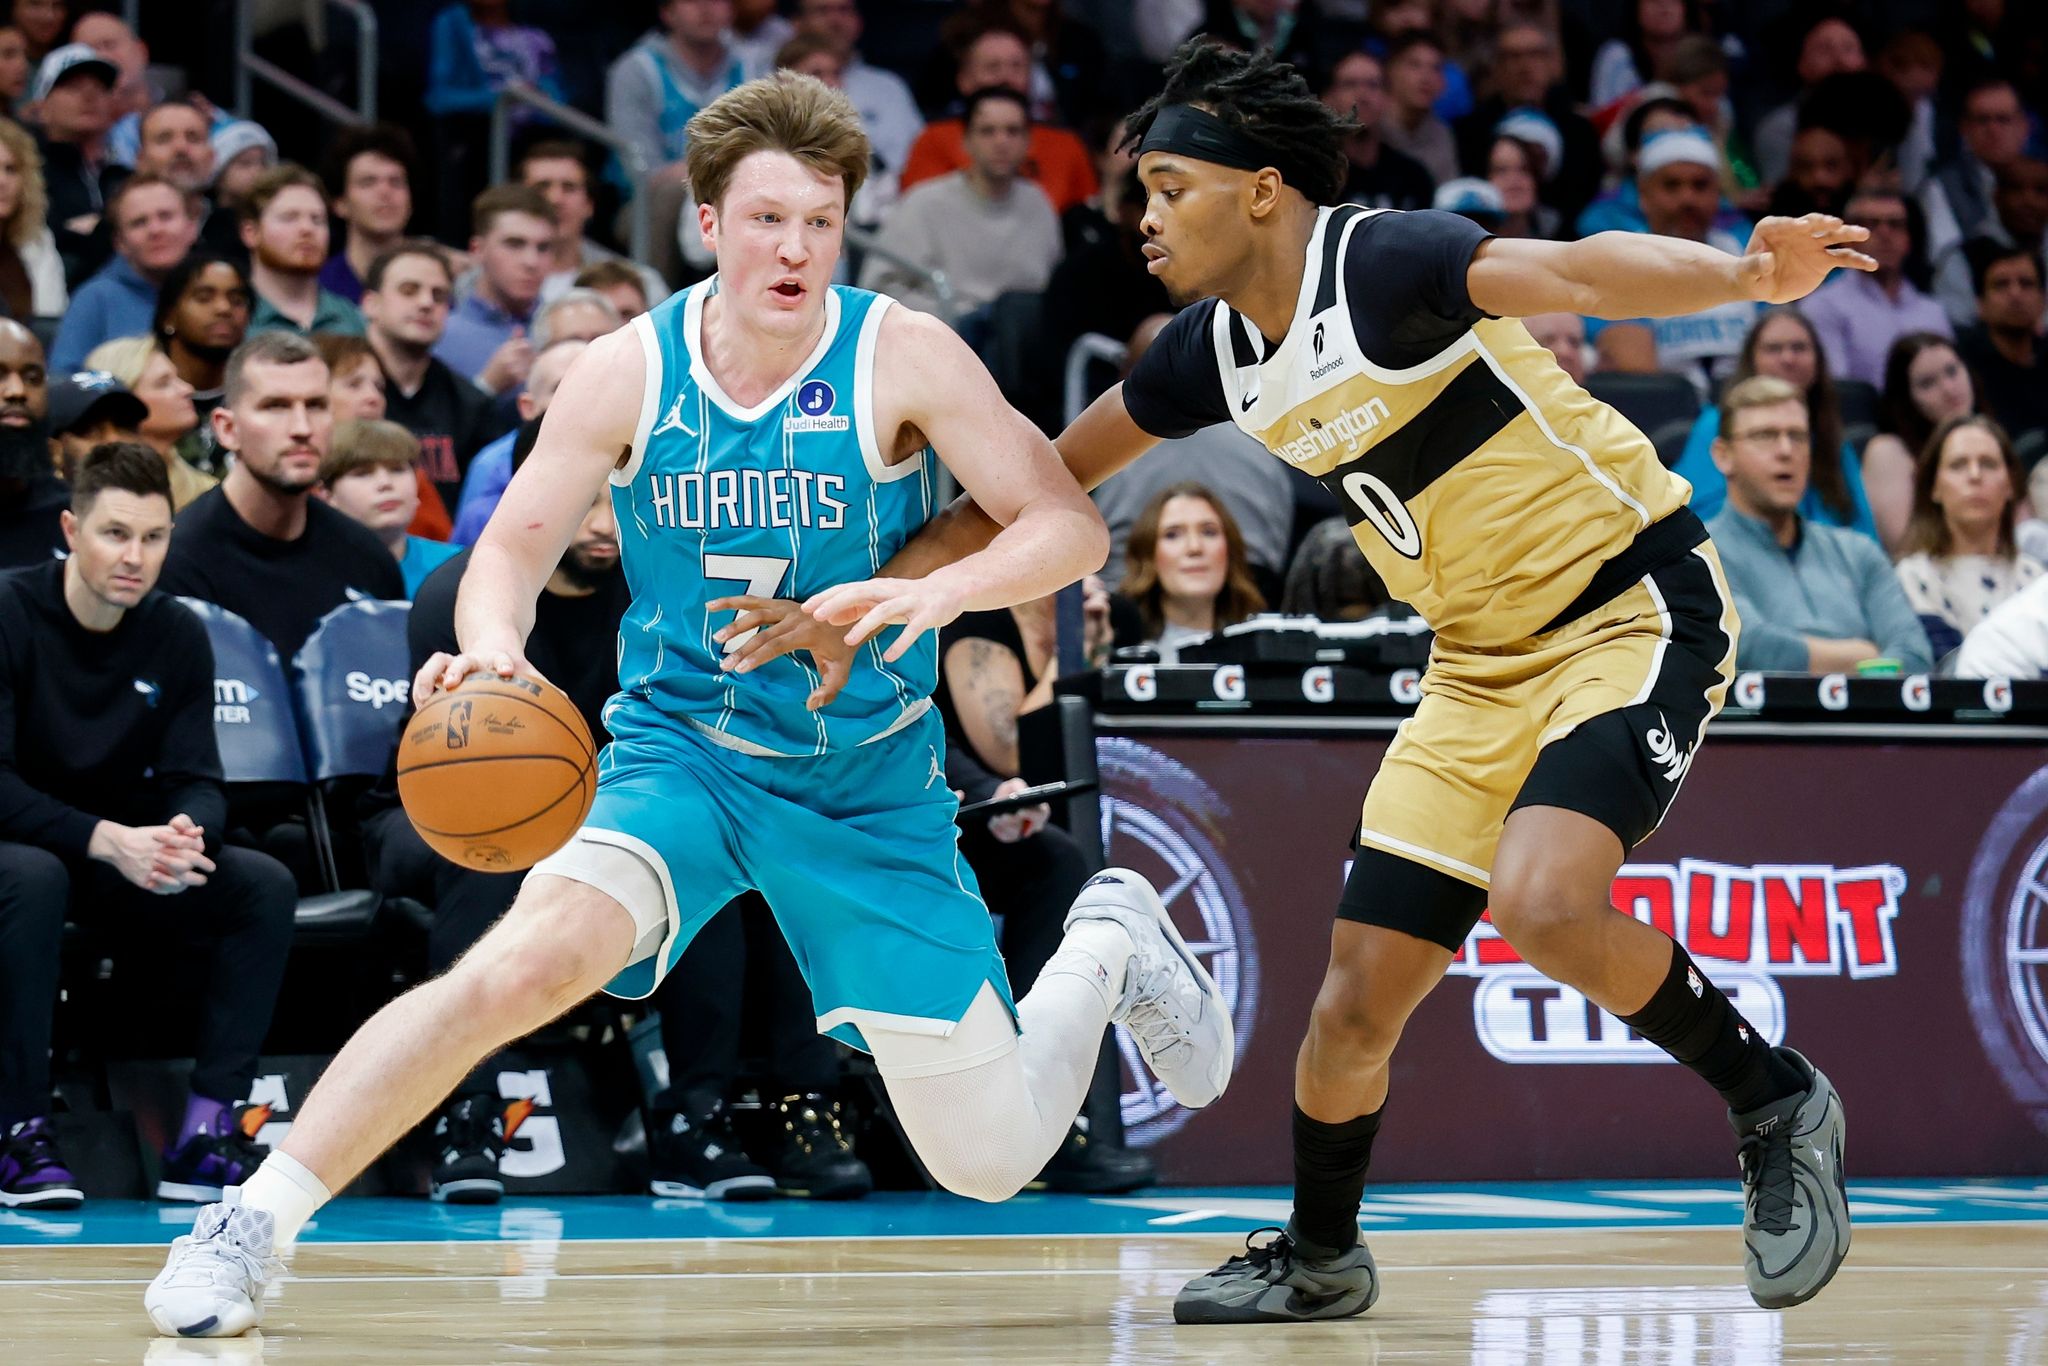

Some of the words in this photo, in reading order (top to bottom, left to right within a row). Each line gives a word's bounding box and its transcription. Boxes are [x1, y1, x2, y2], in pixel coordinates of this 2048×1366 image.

[1309, 354, 1344, 381] Robinhood
[784, 419, 811, 430] Judi
[812, 417, 847, 429] Health
[650, 468, 851, 530] HORNETS
[1341, 471, 1422, 560] 0
[703, 553, 794, 655] 7
